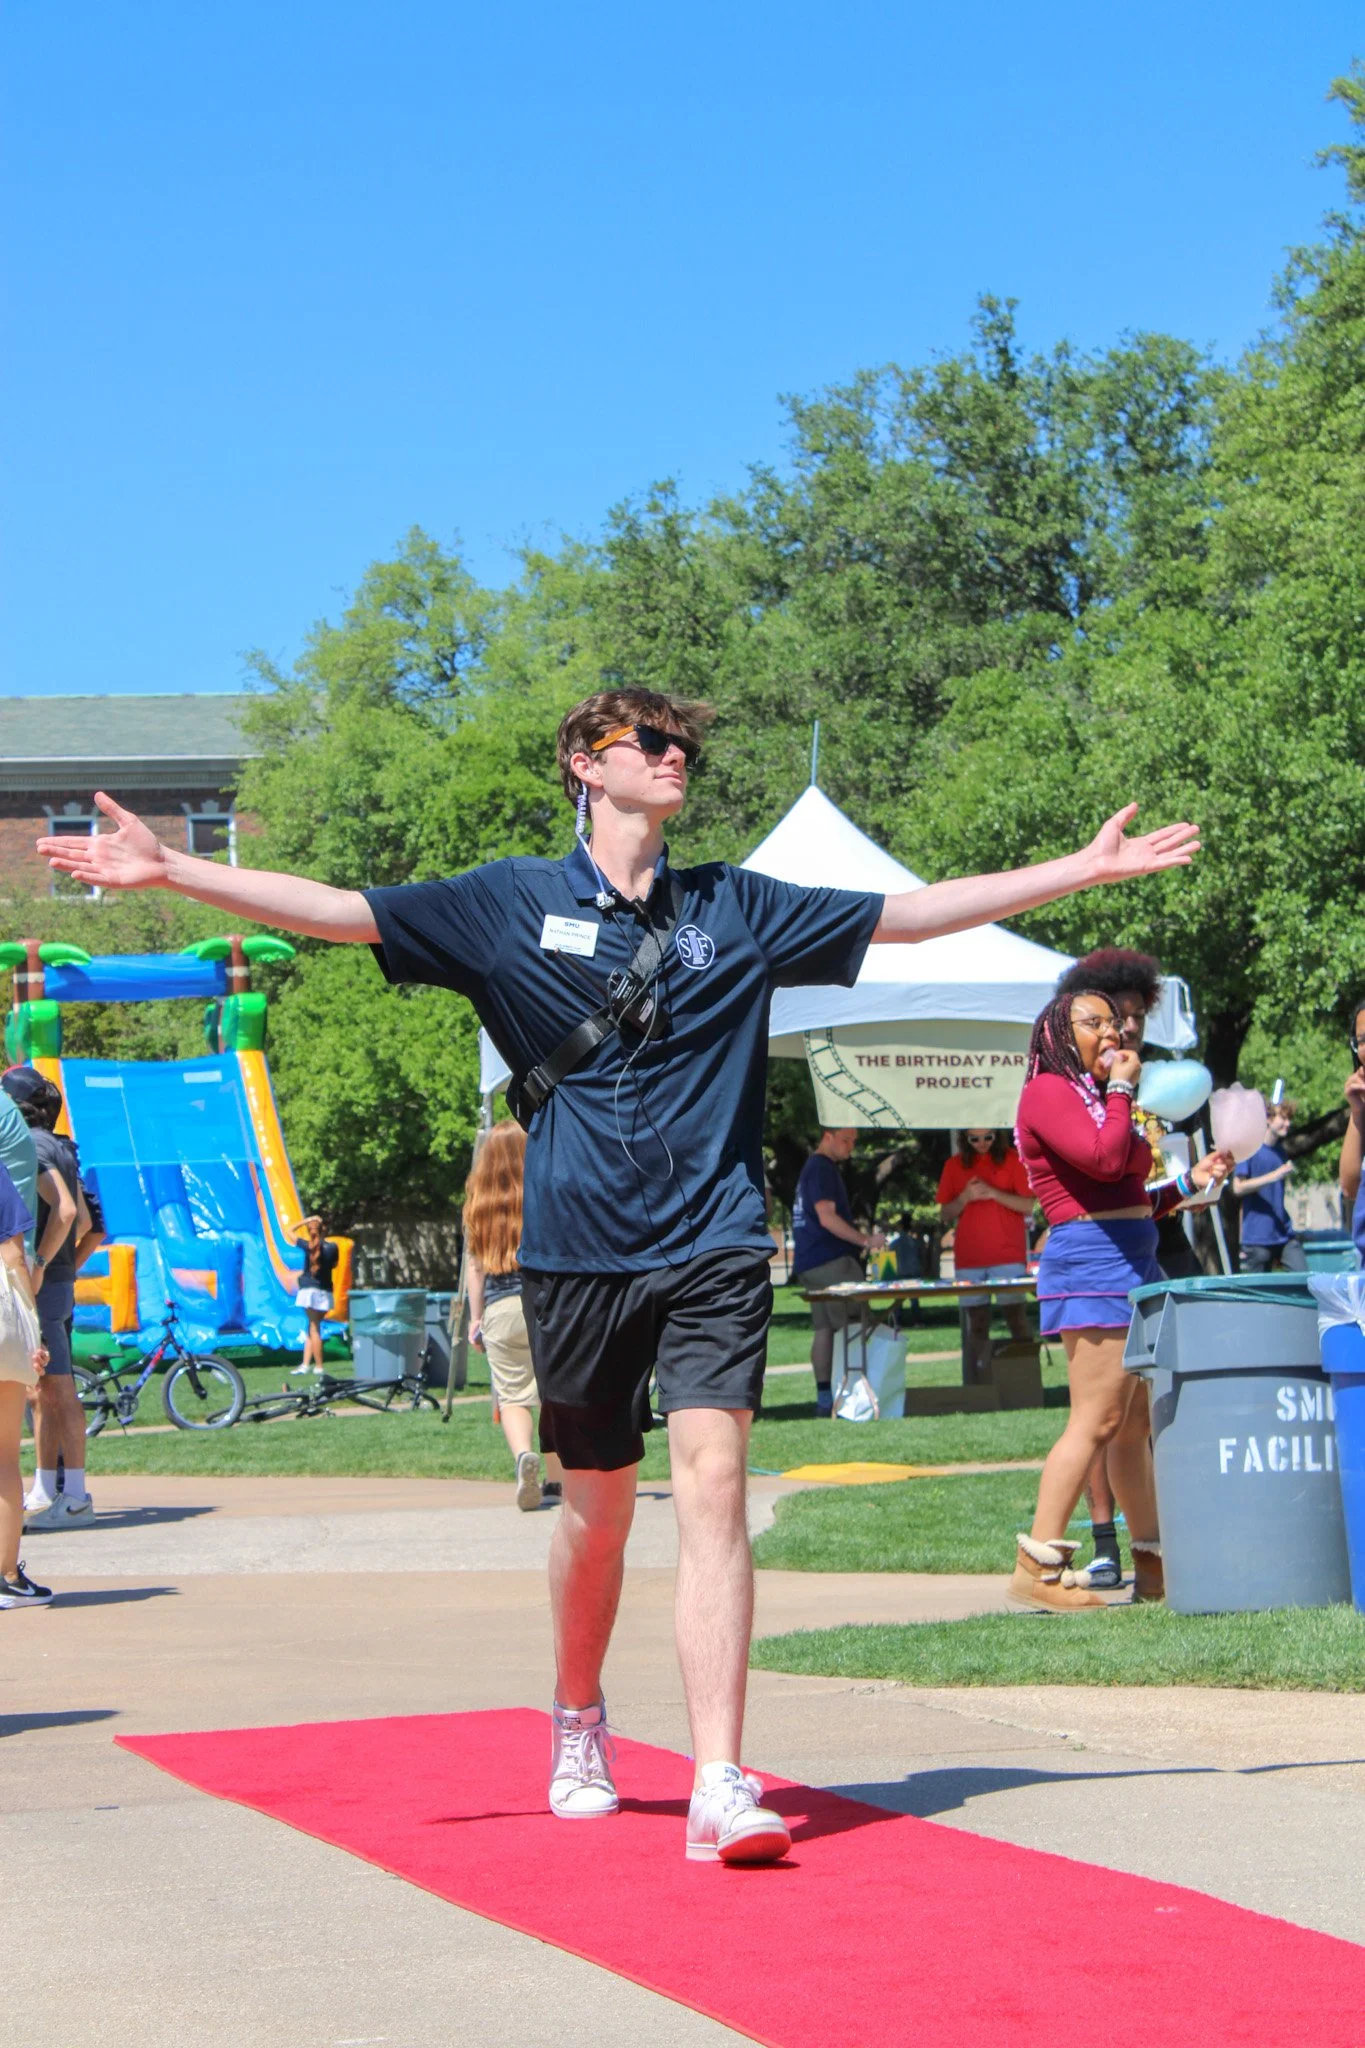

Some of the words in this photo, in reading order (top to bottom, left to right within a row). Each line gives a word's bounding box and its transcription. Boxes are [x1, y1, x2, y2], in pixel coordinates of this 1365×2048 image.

[855, 1054, 890, 1067] THE
[896, 1054, 986, 1067] BIRTHDAY
[990, 1054, 1028, 1067] PAR
[915, 1076, 994, 1089] PROJECT
[1219, 1434, 1336, 1474] FACILI
